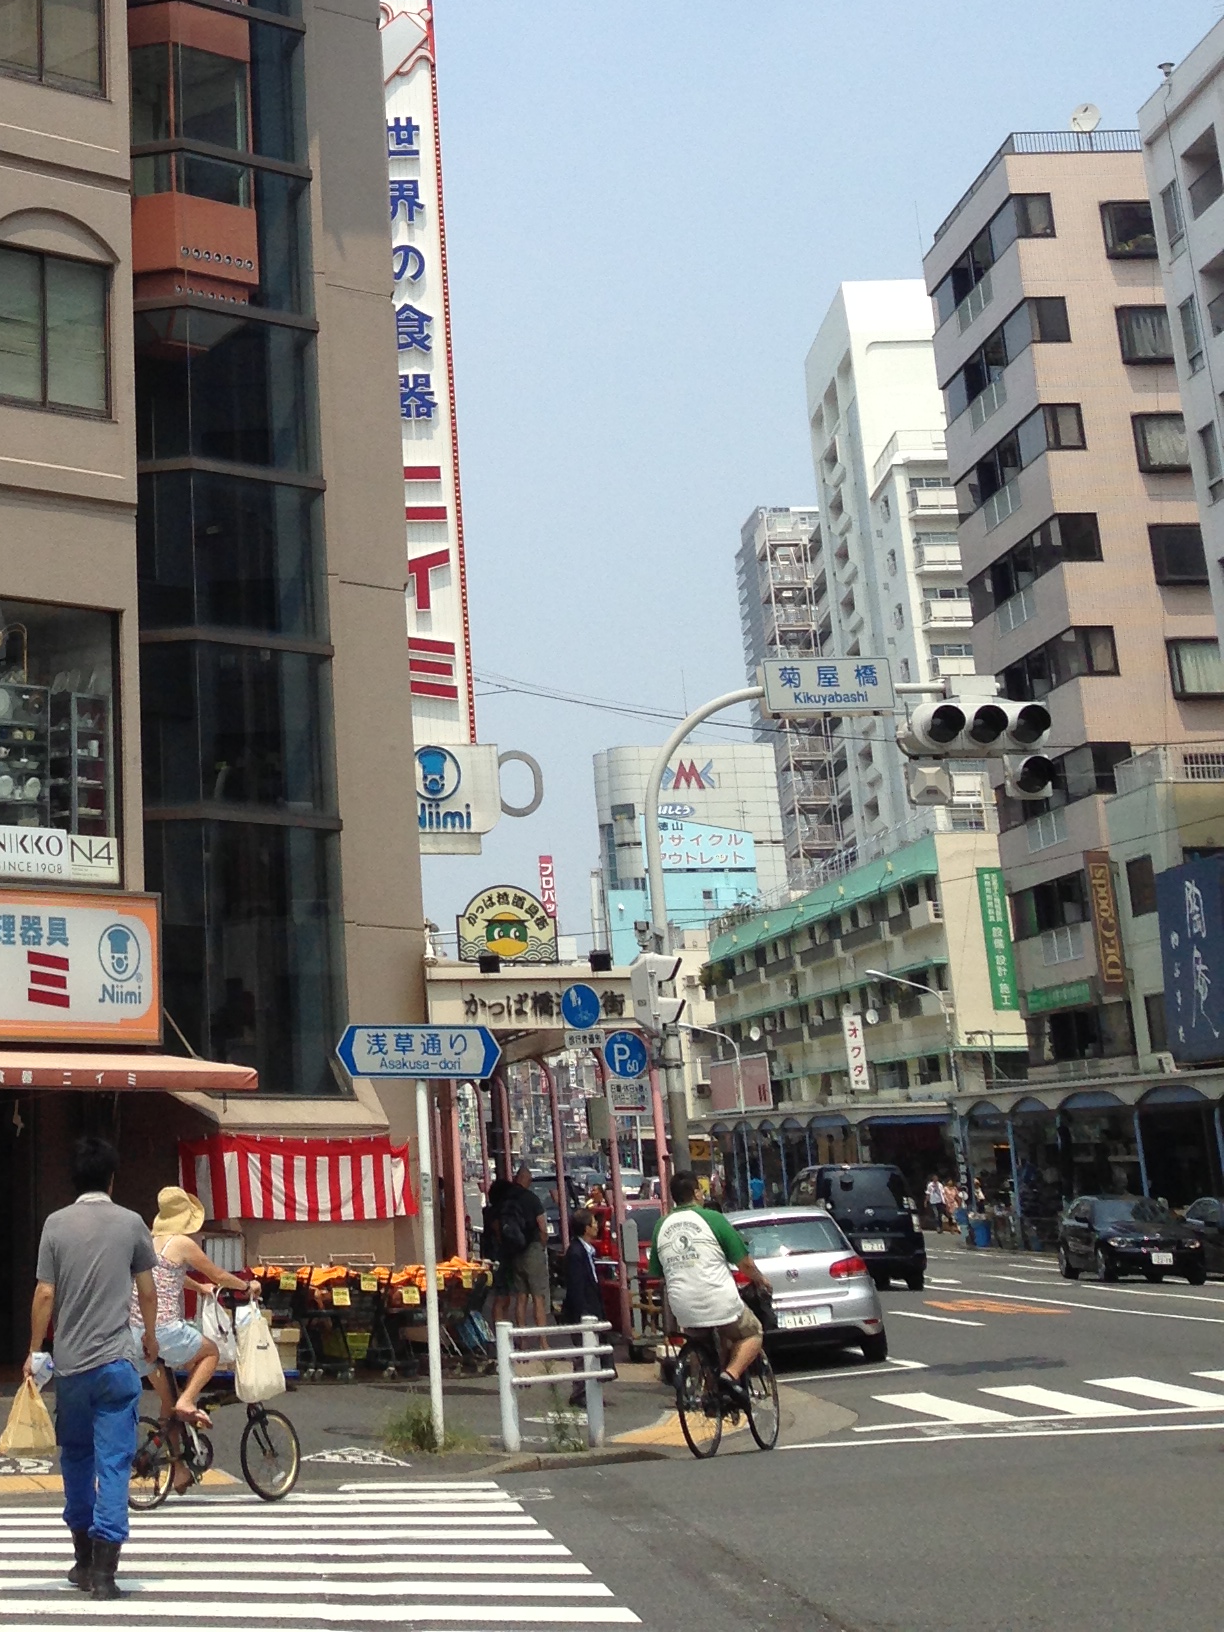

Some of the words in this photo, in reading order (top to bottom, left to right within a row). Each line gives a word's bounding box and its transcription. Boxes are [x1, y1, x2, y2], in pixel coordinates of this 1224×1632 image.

[386, 116, 438, 421] 世界の食器
[404, 466, 459, 699] ニイミ
[778, 664, 878, 688] 菊屋橋
[793, 690, 869, 706] Kikuyabashi
[70, 838, 115, 866] N4
[1092, 868, 1122, 976] Dr.Goods
[98, 983, 142, 1005] Niimi
[464, 990, 626, 1017] かっぱ橋街
[366, 1032, 468, 1056] 浅草通り
[379, 1057, 461, 1070] Asakusa-dori
